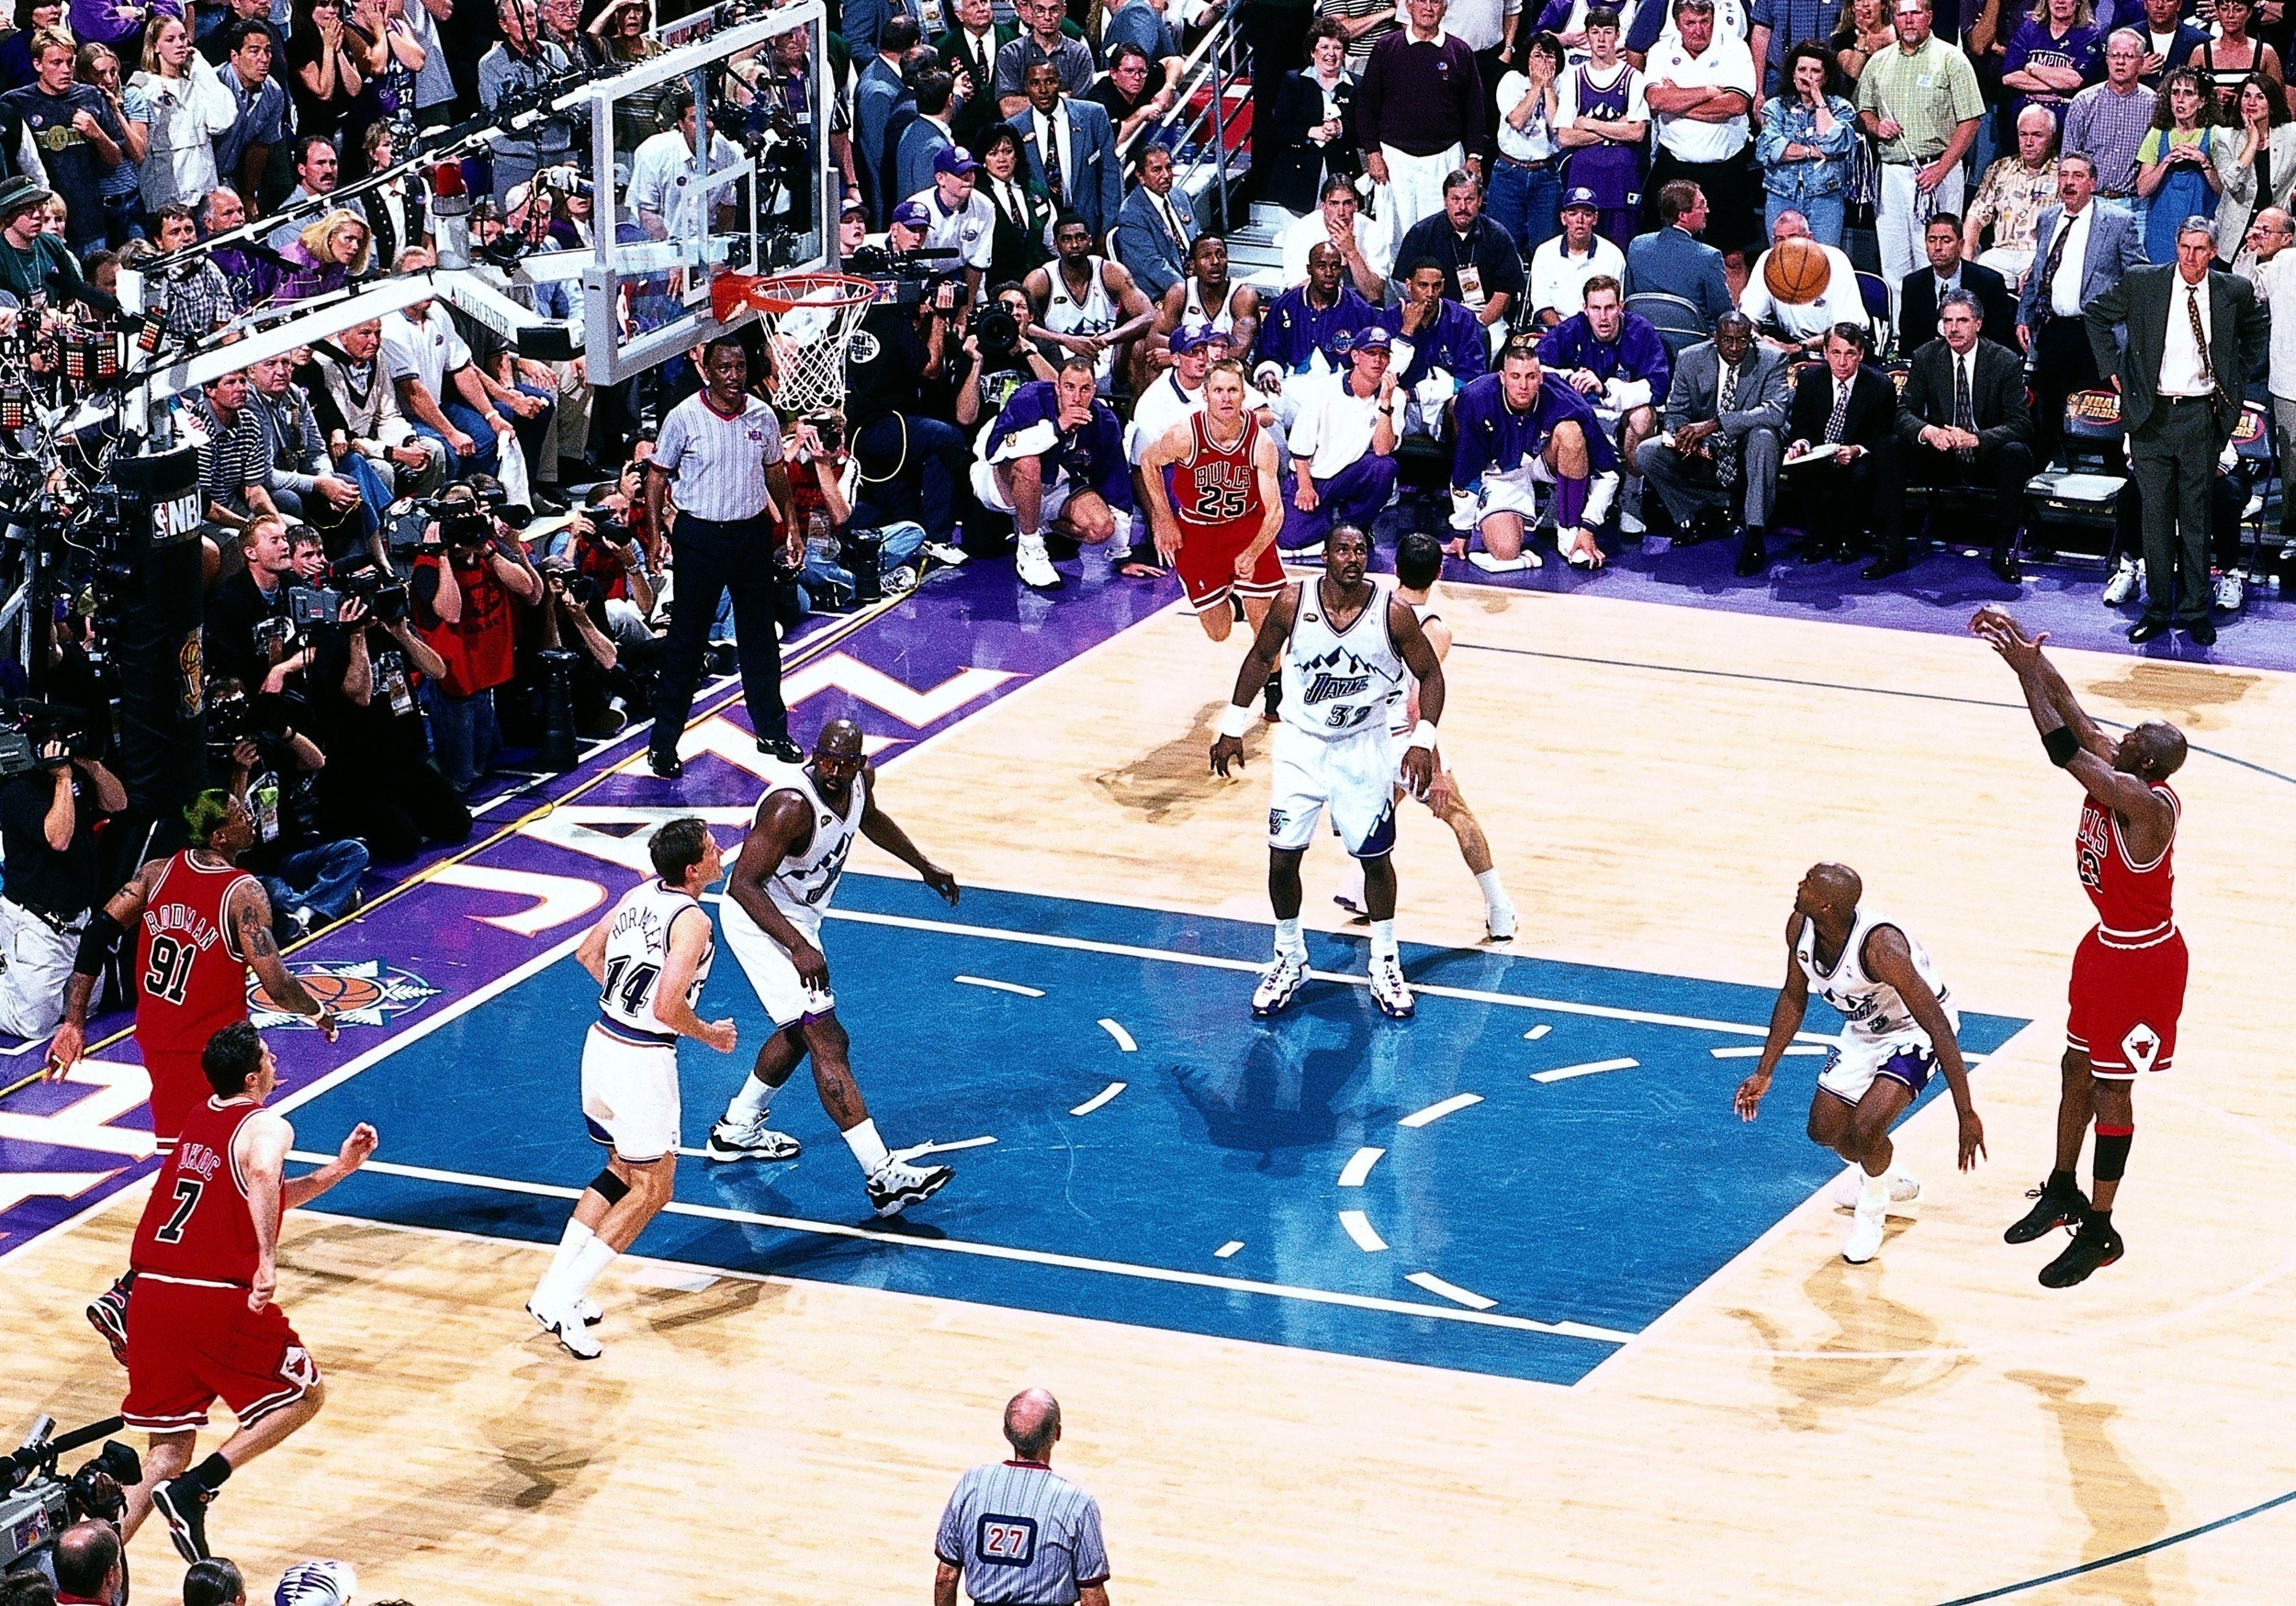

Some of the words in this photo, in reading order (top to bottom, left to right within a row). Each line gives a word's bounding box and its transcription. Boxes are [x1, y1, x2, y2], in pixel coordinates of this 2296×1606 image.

[2077, 404, 2121, 420] Finals
[2080, 394, 2114, 409] NBA
[1195, 460, 1251, 489] BULLS
[1196, 485, 1248, 518] 25
[1304, 672, 1370, 705] JAZZ
[143, 903, 219, 951] RODMAN
[143, 933, 197, 1006] 91
[598, 954, 662, 1018] 14
[153, 1177, 204, 1244] 7
[988, 1526, 1024, 1555] 27
